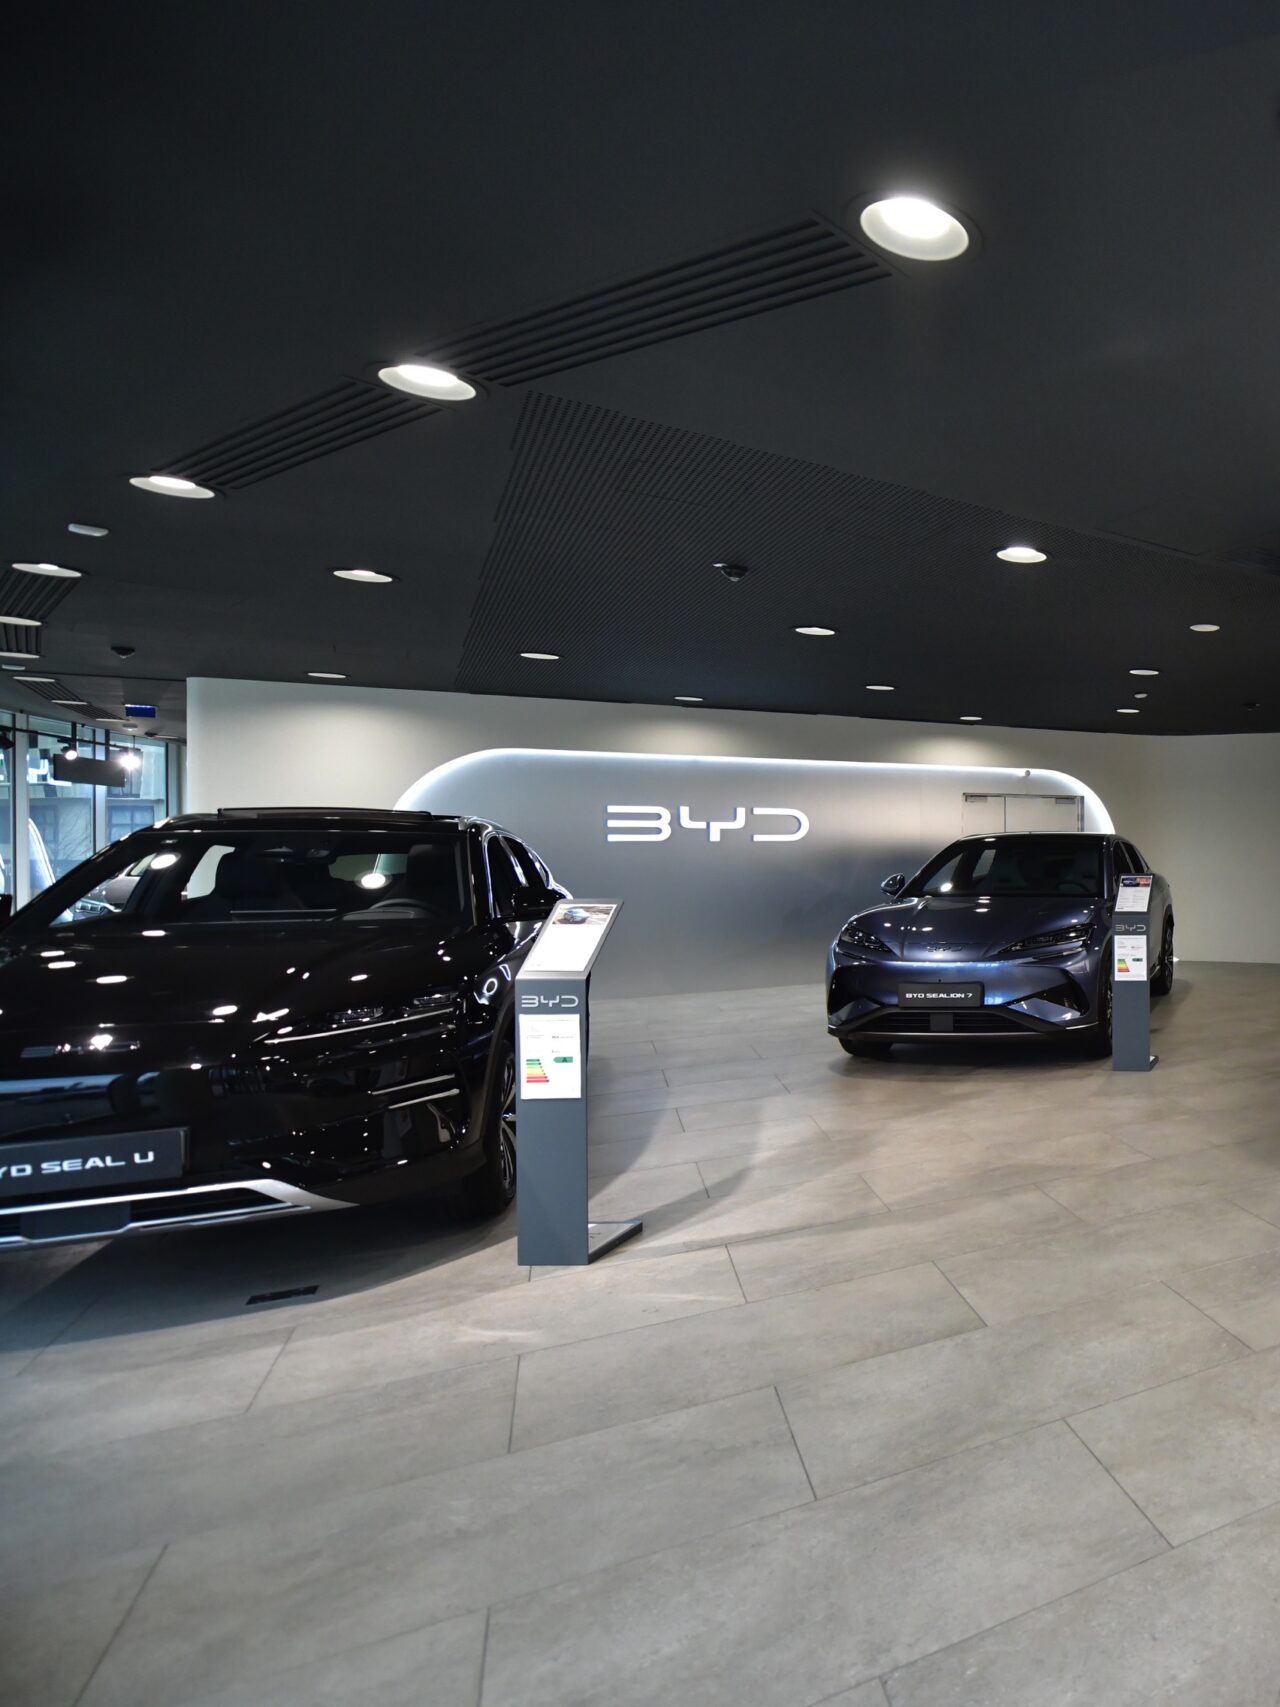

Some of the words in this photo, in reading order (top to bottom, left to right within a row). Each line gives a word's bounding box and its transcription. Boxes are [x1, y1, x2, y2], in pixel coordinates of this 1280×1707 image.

[605, 805, 810, 842] BYD
[1115, 924, 1147, 932] BYD
[521, 995, 579, 1008] BYD
[41, 1156, 126, 1174] SEAL
[133, 1151, 154, 1163] U
